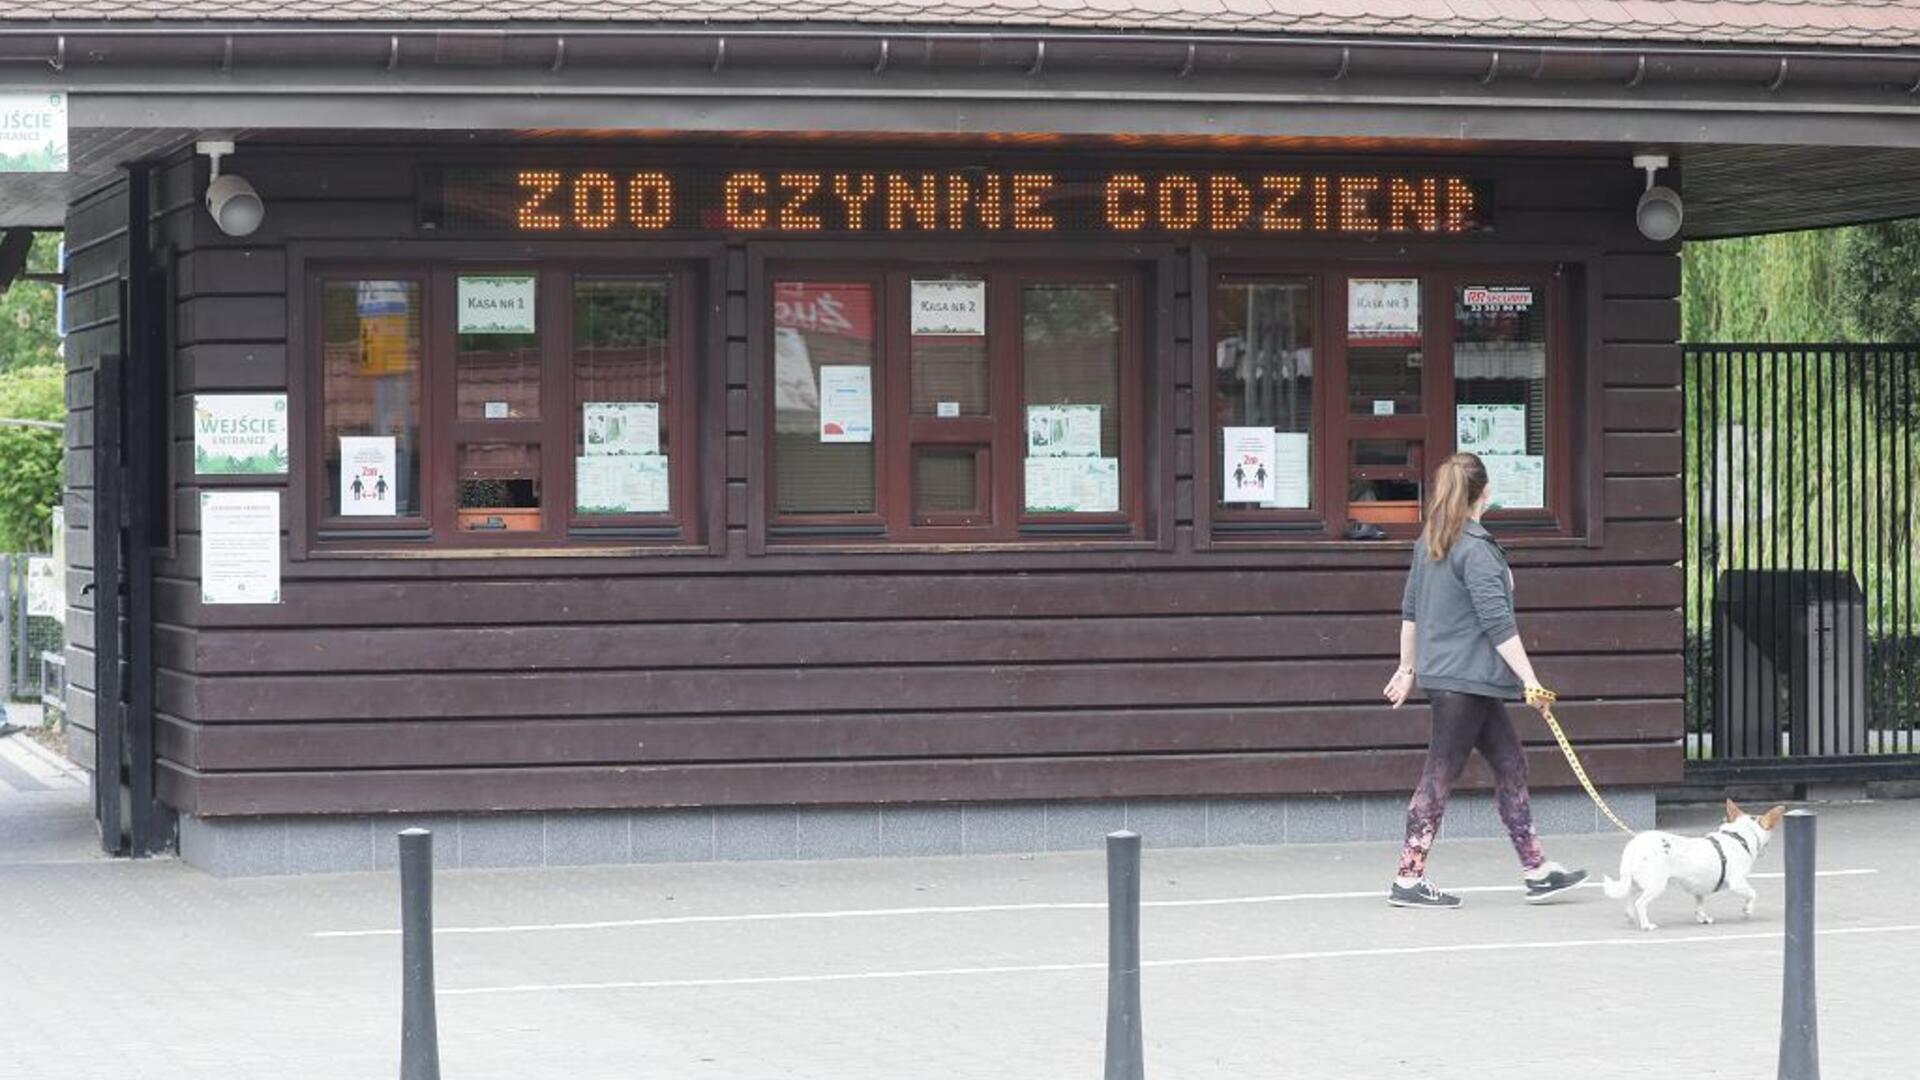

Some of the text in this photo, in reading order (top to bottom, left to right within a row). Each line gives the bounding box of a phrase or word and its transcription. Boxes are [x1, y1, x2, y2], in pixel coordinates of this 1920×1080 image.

[518, 172, 672, 229] ZOO
[725, 174, 1054, 230] CZYNNE
[468, 297, 498, 310] KASA
[500, 299, 514, 309] NR
[968, 300, 976, 312] 2
[200, 415, 277, 434] WEJŚCIE
